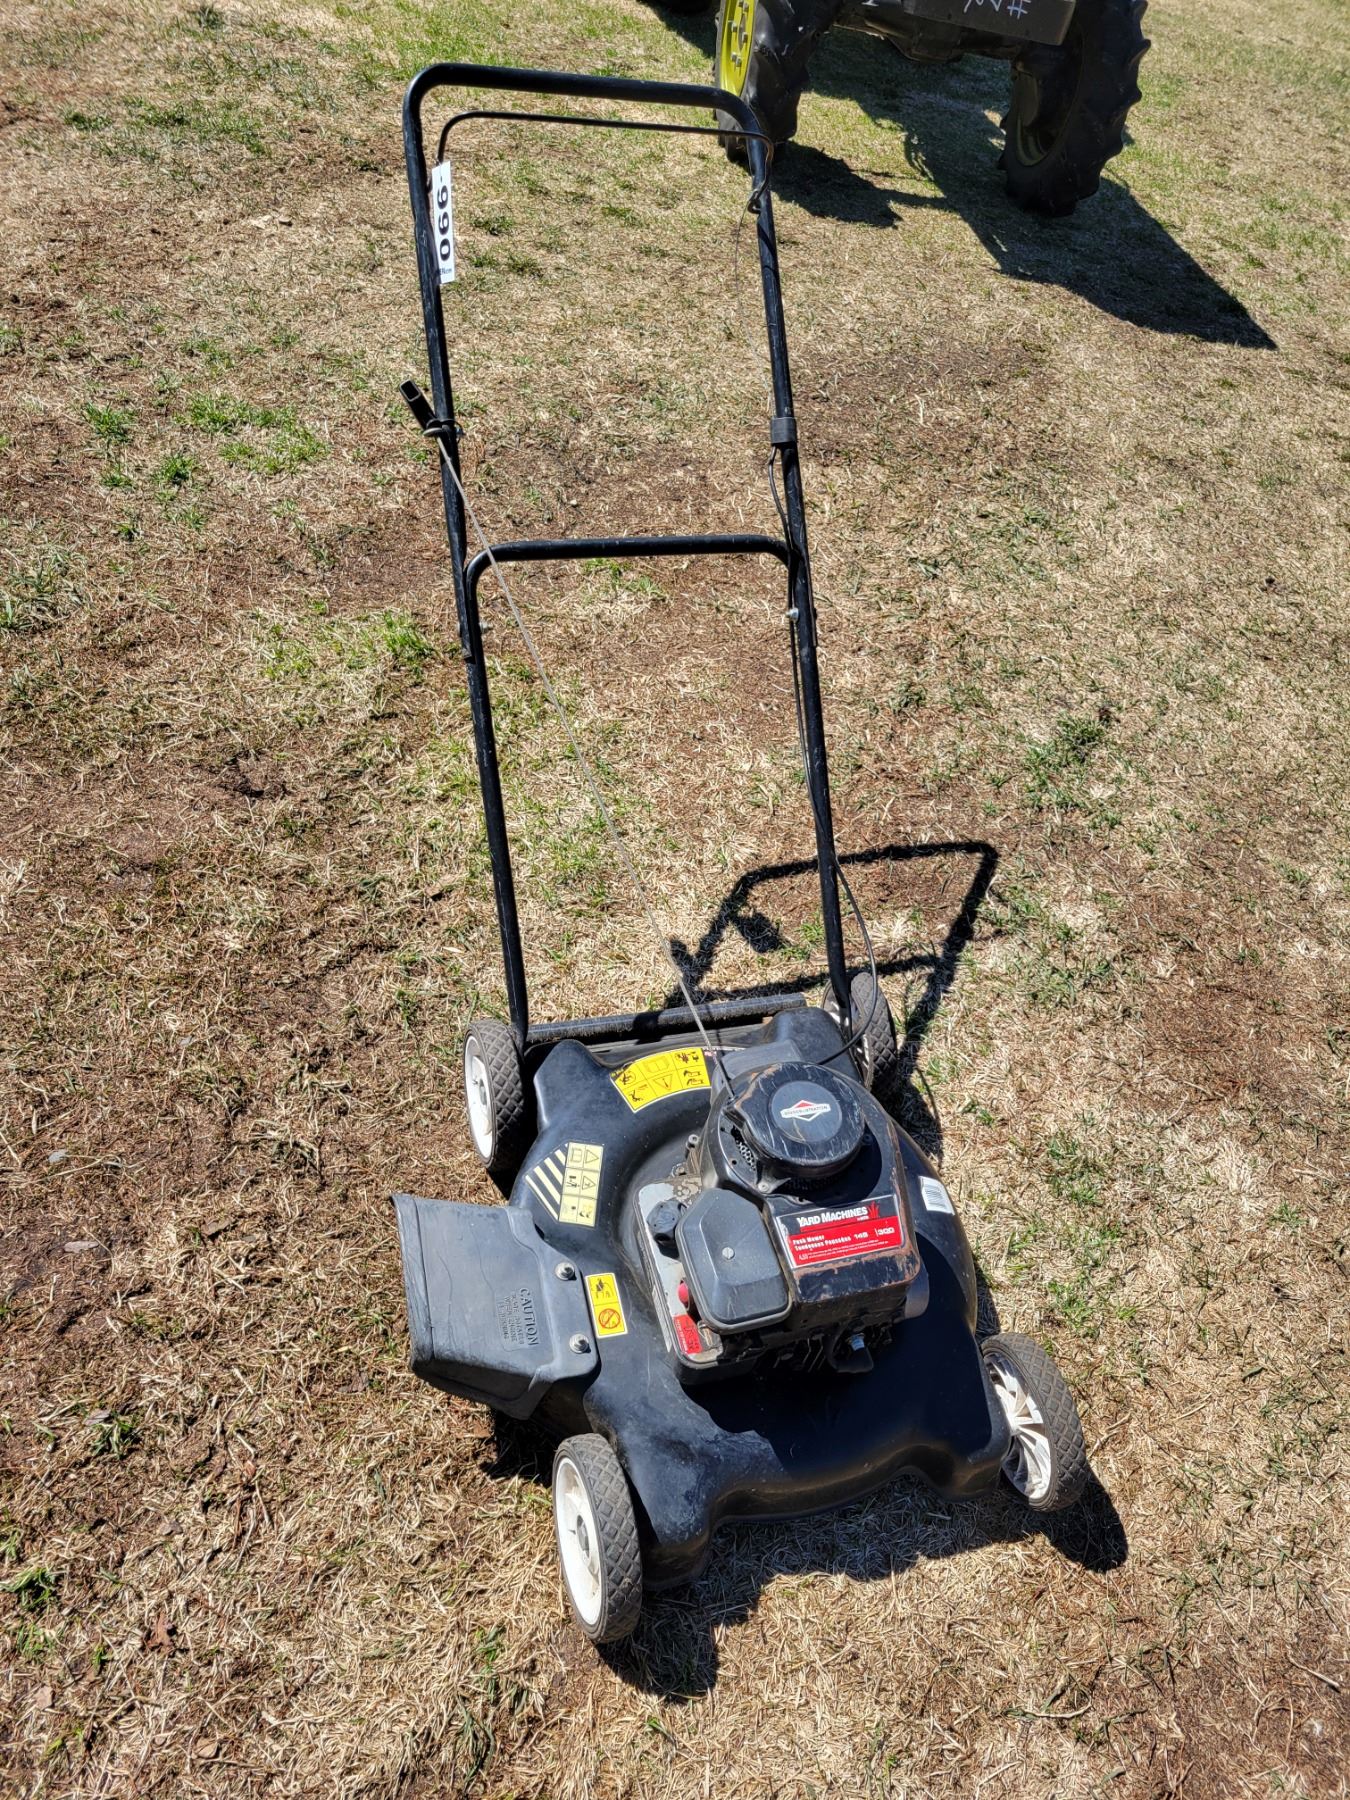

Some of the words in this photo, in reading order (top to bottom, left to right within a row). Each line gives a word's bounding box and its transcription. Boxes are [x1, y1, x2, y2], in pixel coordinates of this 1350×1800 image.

[796, 1215, 821, 1227] YARD
[820, 1206, 868, 1223] MACHINES
[520, 1288, 539, 1346] CAUTION
